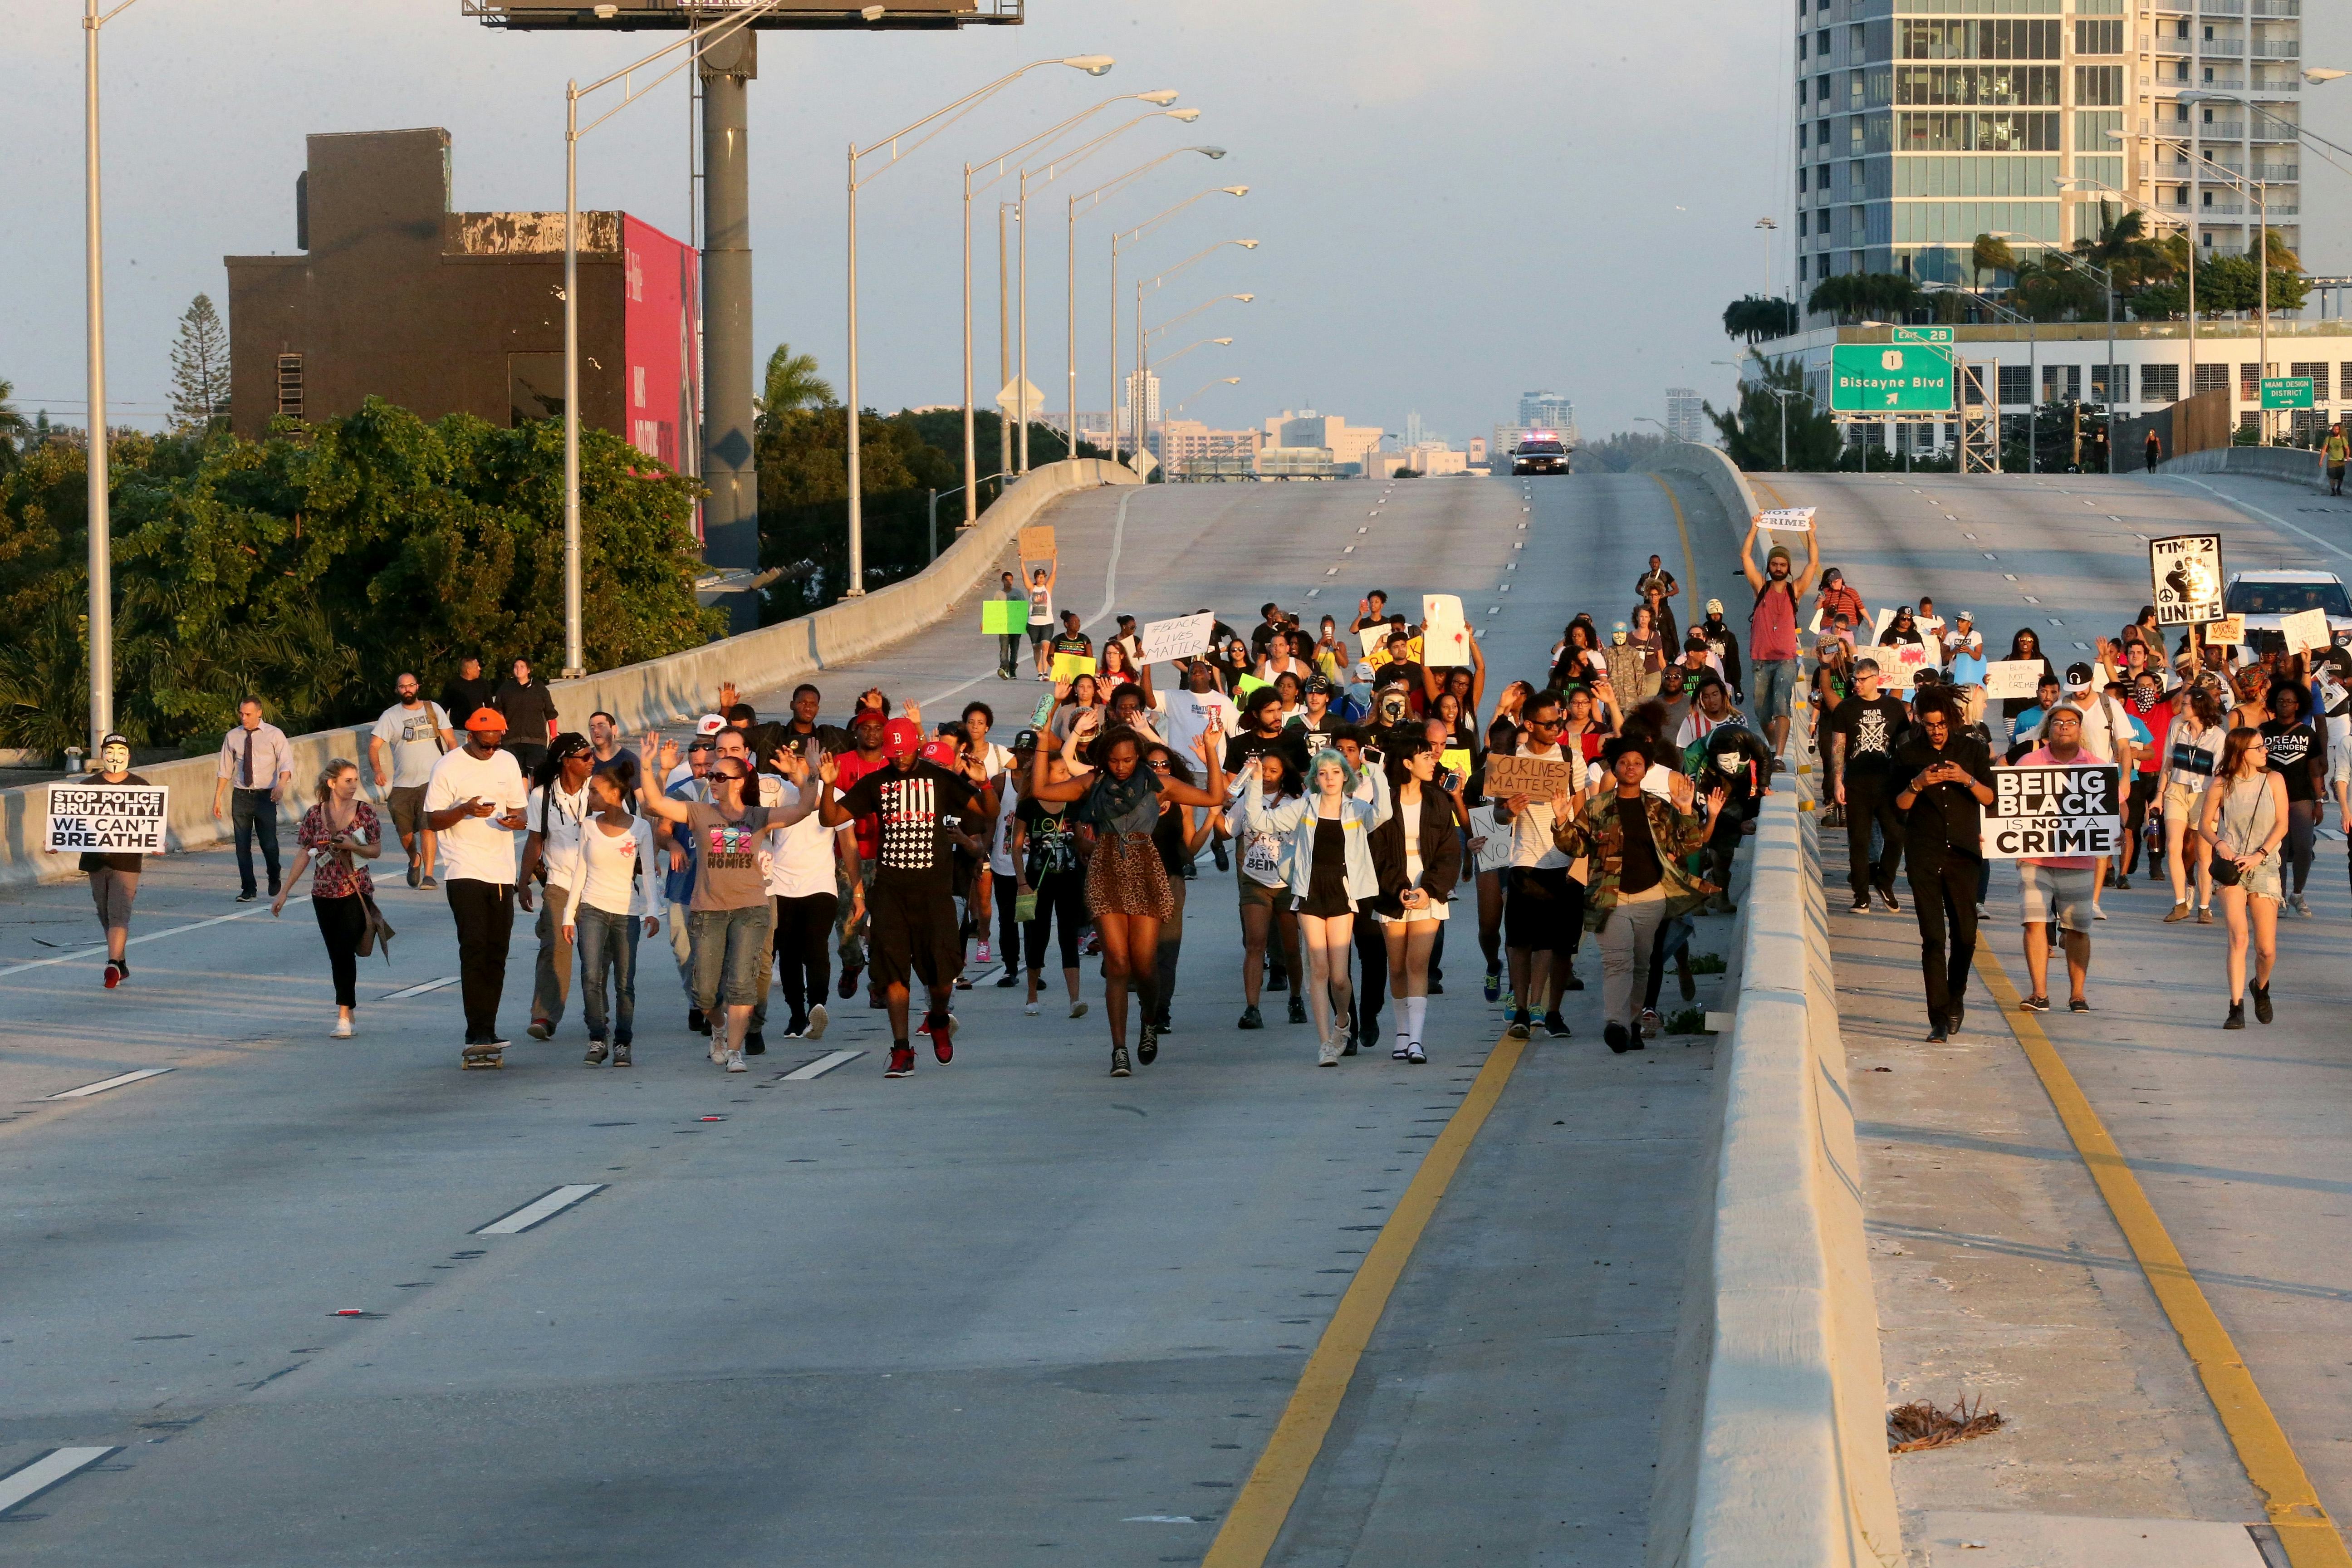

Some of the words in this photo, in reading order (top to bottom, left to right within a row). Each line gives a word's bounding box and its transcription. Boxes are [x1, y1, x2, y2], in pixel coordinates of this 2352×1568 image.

[1930, 331, 1947, 340] 2B
[1891, 356, 1894, 366] 1
[1840, 377, 1905, 390] Biscayne
[1912, 377, 1944, 387] Blvd
[1760, 518, 1806, 527] CRIME
[2156, 540, 2195, 554] TIME
[2200, 539, 2213, 552] 2
[2160, 601, 2221, 623] UNITE
[1152, 618, 1200, 633] #BLACK
[2284, 612, 2320, 628] BLACK
[2212, 622, 2239, 635] FAIRNESS
[2295, 624, 2318, 637] LIVES
[1155, 631, 1194, 645] LIVES
[1145, 640, 1202, 660] MATTER
[1863, 649, 1896, 663] STOP
[893, 733, 902, 744] B
[2264, 735, 2309, 745] DREAM
[1497, 757, 1529, 775] OUR
[1531, 761, 1567, 778] LIVES
[1997, 771, 2106, 795] BEING
[54, 791, 98, 803] STOP
[101, 792, 160, 804] POLICE
[1998, 793, 2107, 816] BLACK
[54, 802, 159, 816] BRUTALITY!
[53, 818, 87, 831] WE
[95, 818, 159, 832] CAN'T
[2006, 819, 2023, 830] IS
[2032, 818, 2076, 829] NOT
[2085, 818, 2099, 828] A
[52, 832, 158, 848] BREATHE
[1996, 829, 2110, 854] CRIME
[1479, 843, 1509, 864] NO
[708, 858, 752, 869] HOMIES
[1246, 858, 1278, 871] BEIN
